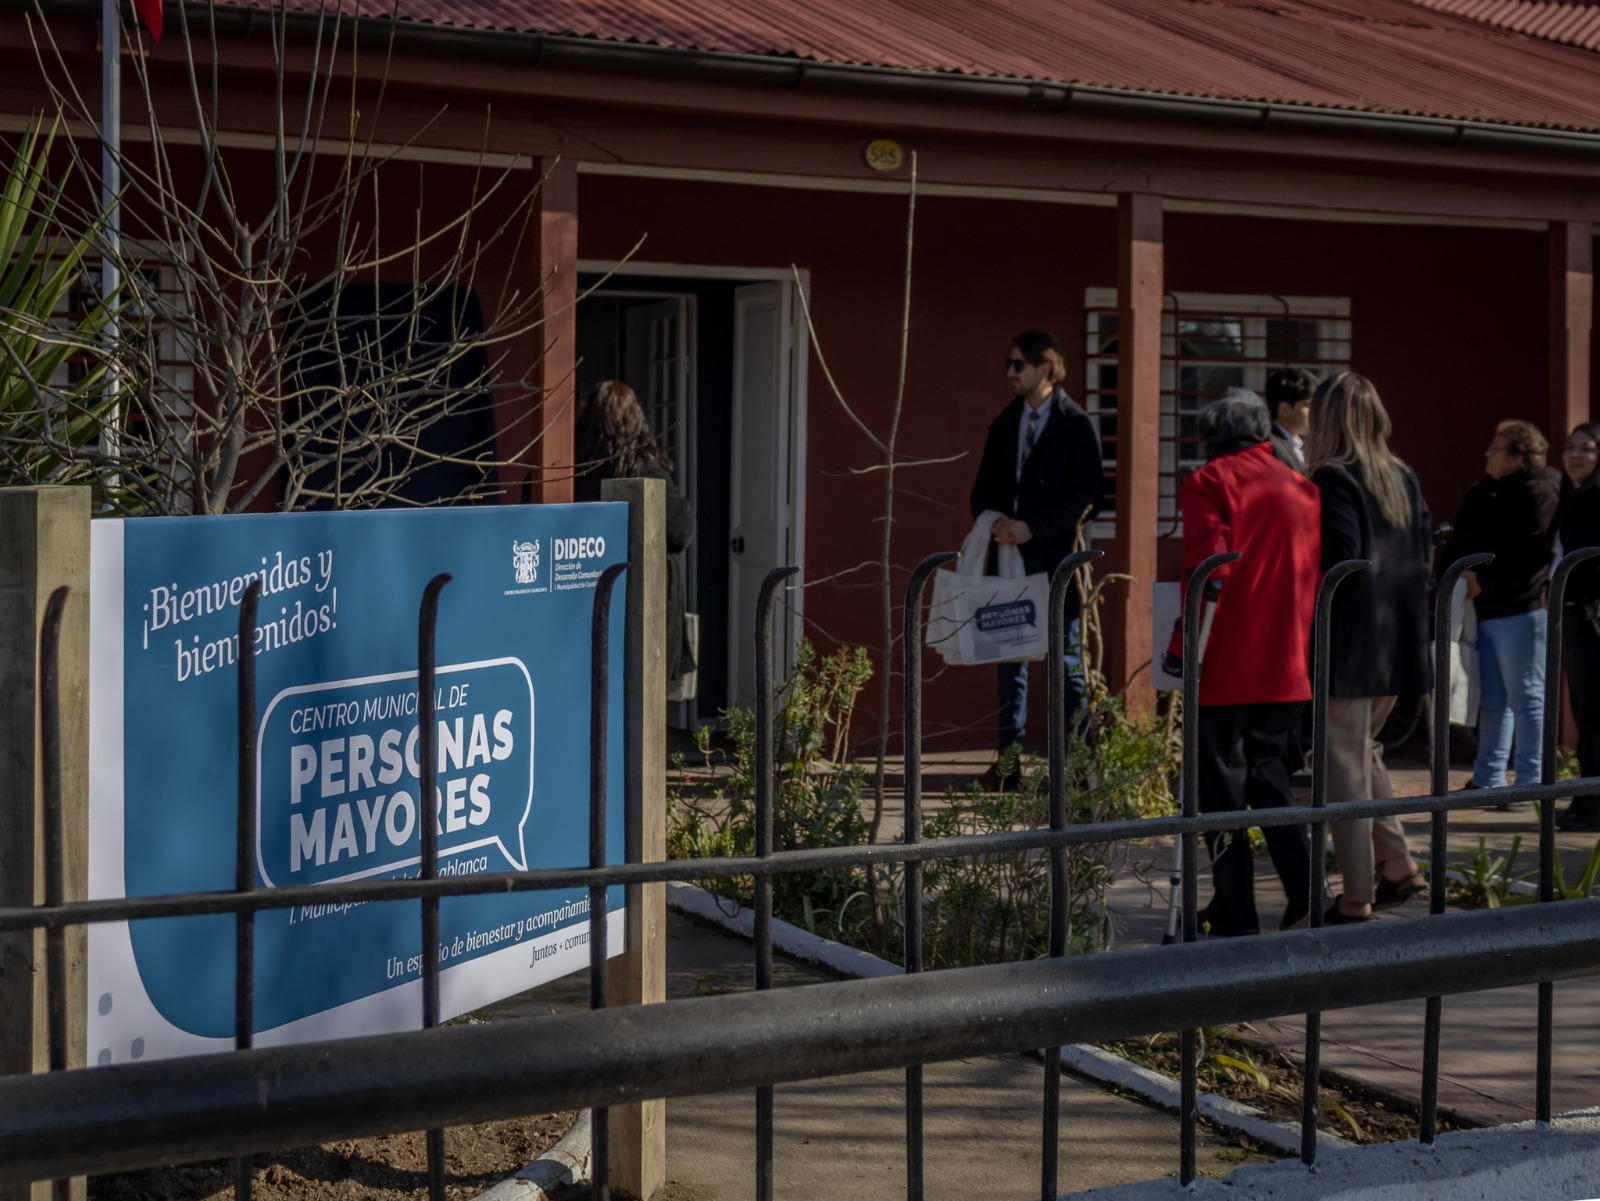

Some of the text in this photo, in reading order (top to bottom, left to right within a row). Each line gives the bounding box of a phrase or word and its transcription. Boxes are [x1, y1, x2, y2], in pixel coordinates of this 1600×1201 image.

[555, 536, 606, 560] DIDECO
[314, 549, 333, 592] y
[555, 561, 582, 571] Dirección de
[555, 570, 603, 581] Desarrollo Comunitari
[980, 605, 1031, 619] PERSONAS
[981, 615, 1027, 629] MAYORES
[290, 683, 470, 735] CENTRO MUNICIL DE
[386, 956, 404, 979] Un
[406, 942, 449, 976] espio
[451, 936, 464, 958] de
[466, 923, 516, 952] bienestar
[514, 920, 524, 942] y
[529, 942, 558, 969] Juntos
